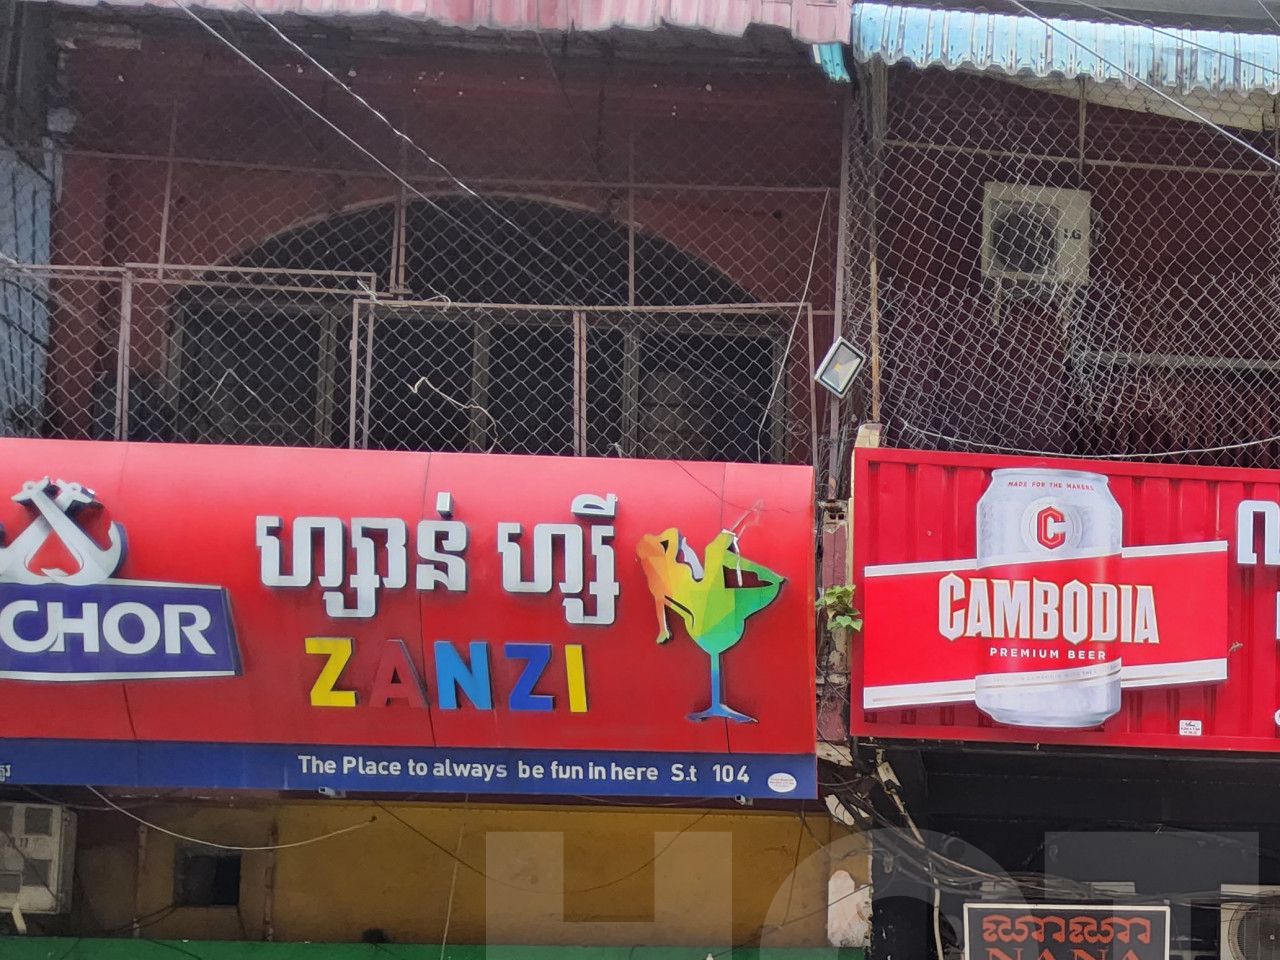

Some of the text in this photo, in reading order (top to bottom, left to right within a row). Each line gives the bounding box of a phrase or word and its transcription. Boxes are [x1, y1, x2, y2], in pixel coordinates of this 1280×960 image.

[1008, 480, 1028, 488] MADE
[1031, 481, 1046, 489] FOR
[1050, 481, 1063, 489] THE
[938, 572, 1160, 645] CAMBODIA
[989, 646, 1107, 662] PREMIUM BEER
[304, 636, 589, 713] ZANZI
[298, 755, 336, 776] The
[342, 755, 402, 777] Place
[408, 759, 428, 777] to
[433, 759, 508, 781] always
[519, 761, 545, 780] be
[550, 761, 584, 780] fun
[588, 762, 607, 780] in
[611, 763, 659, 782] here
[713, 764, 751, 784] 104
